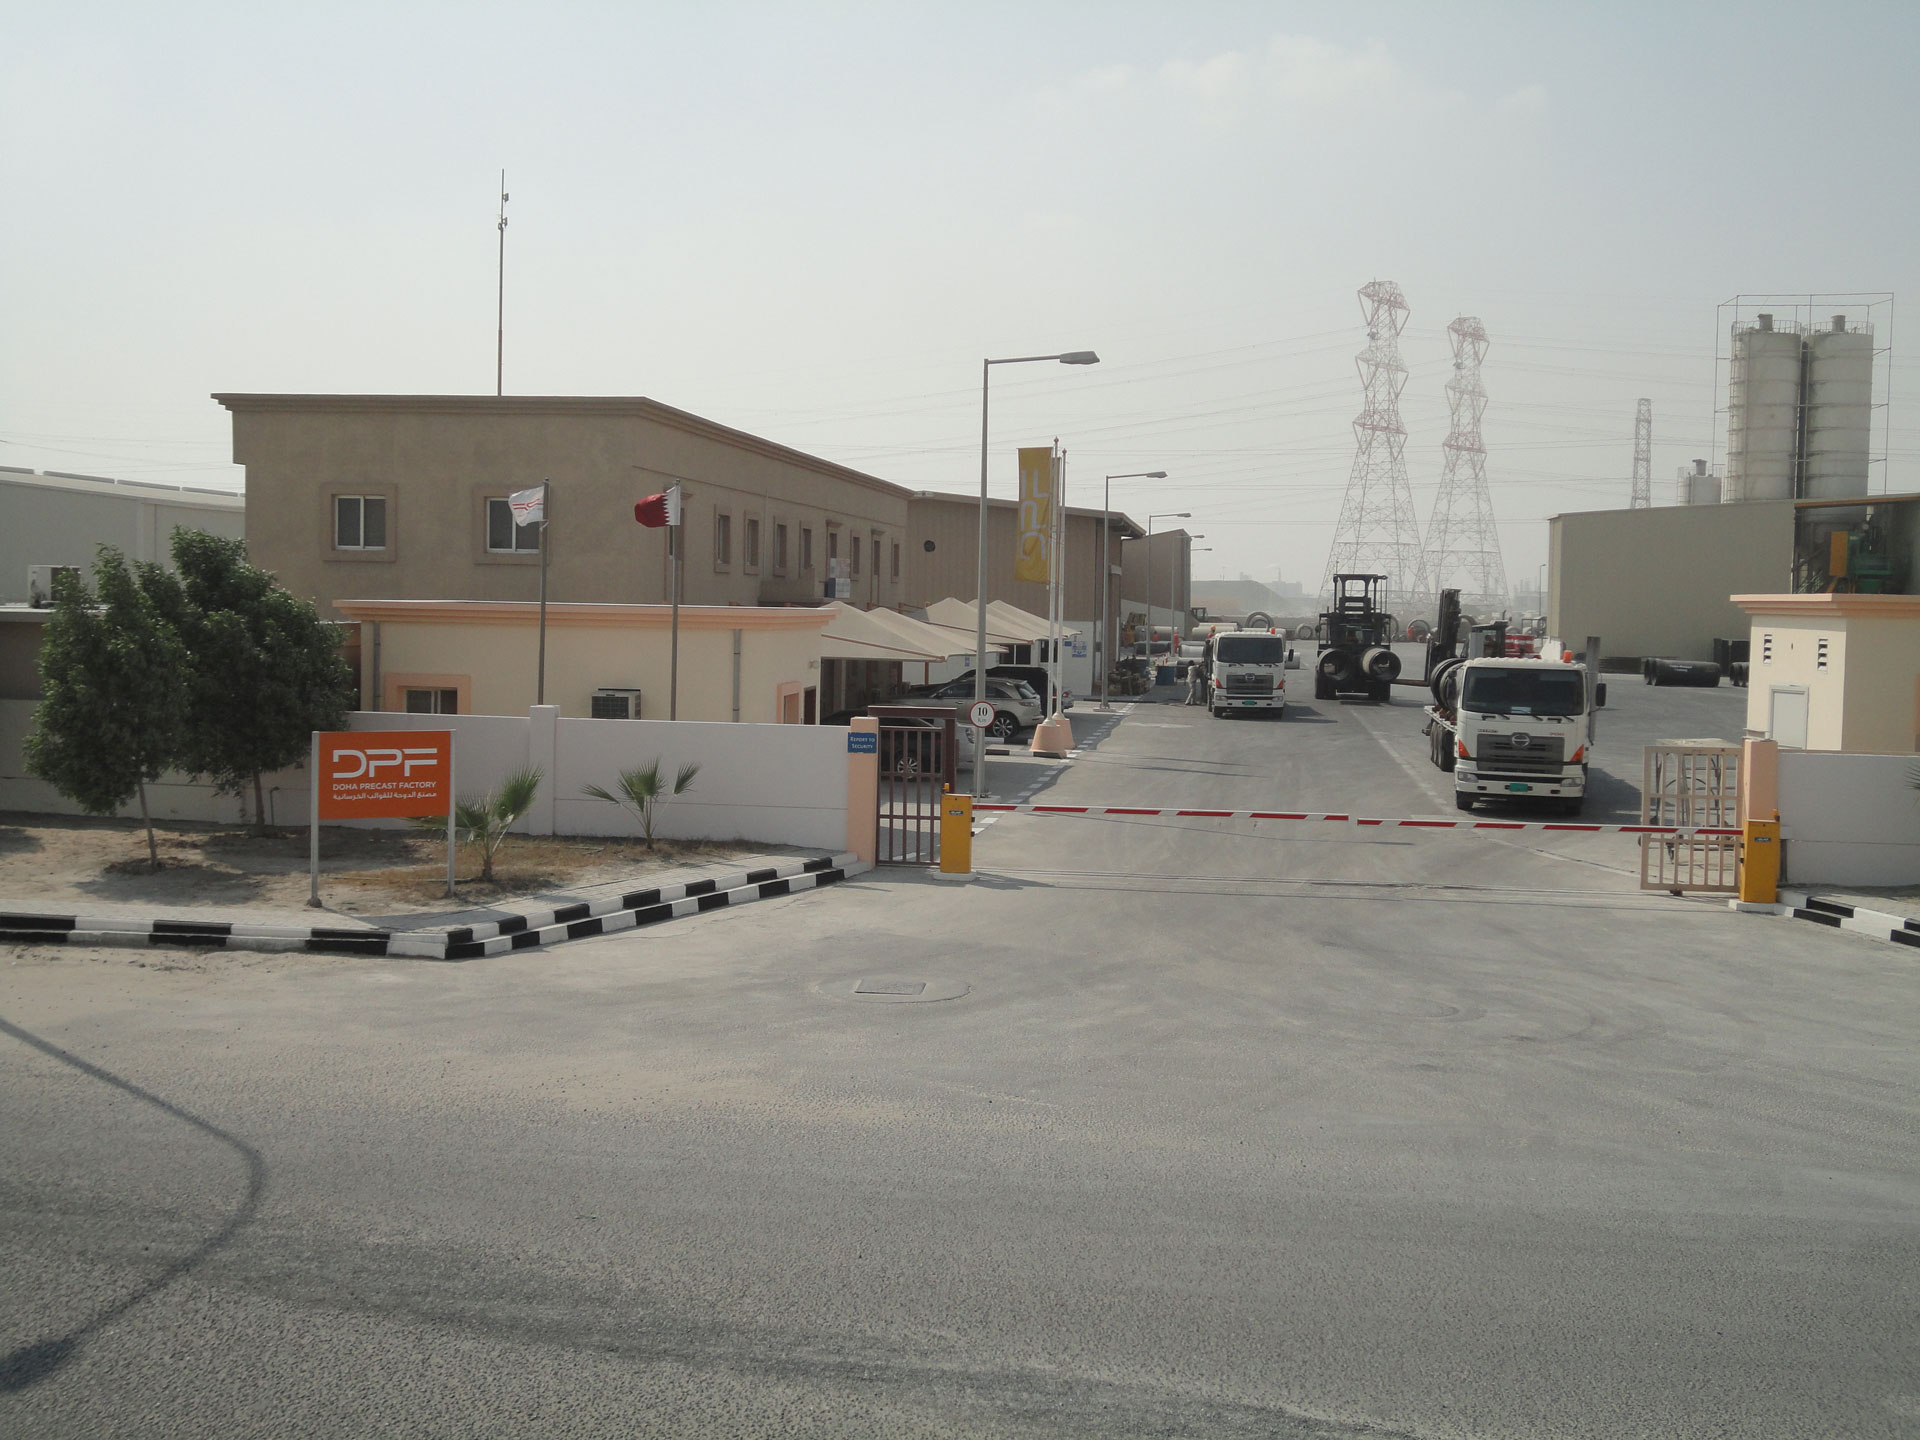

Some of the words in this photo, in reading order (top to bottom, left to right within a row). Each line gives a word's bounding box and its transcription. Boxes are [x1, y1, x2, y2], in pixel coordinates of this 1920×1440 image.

[977, 706, 988, 717] 10
[332, 747, 438, 779] DPF
[332, 783, 358, 791] DOHA
[359, 782, 397, 790] PRECAST
[399, 781, 437, 789] FACTORY
[393, 791, 417, 799] الدوحة
